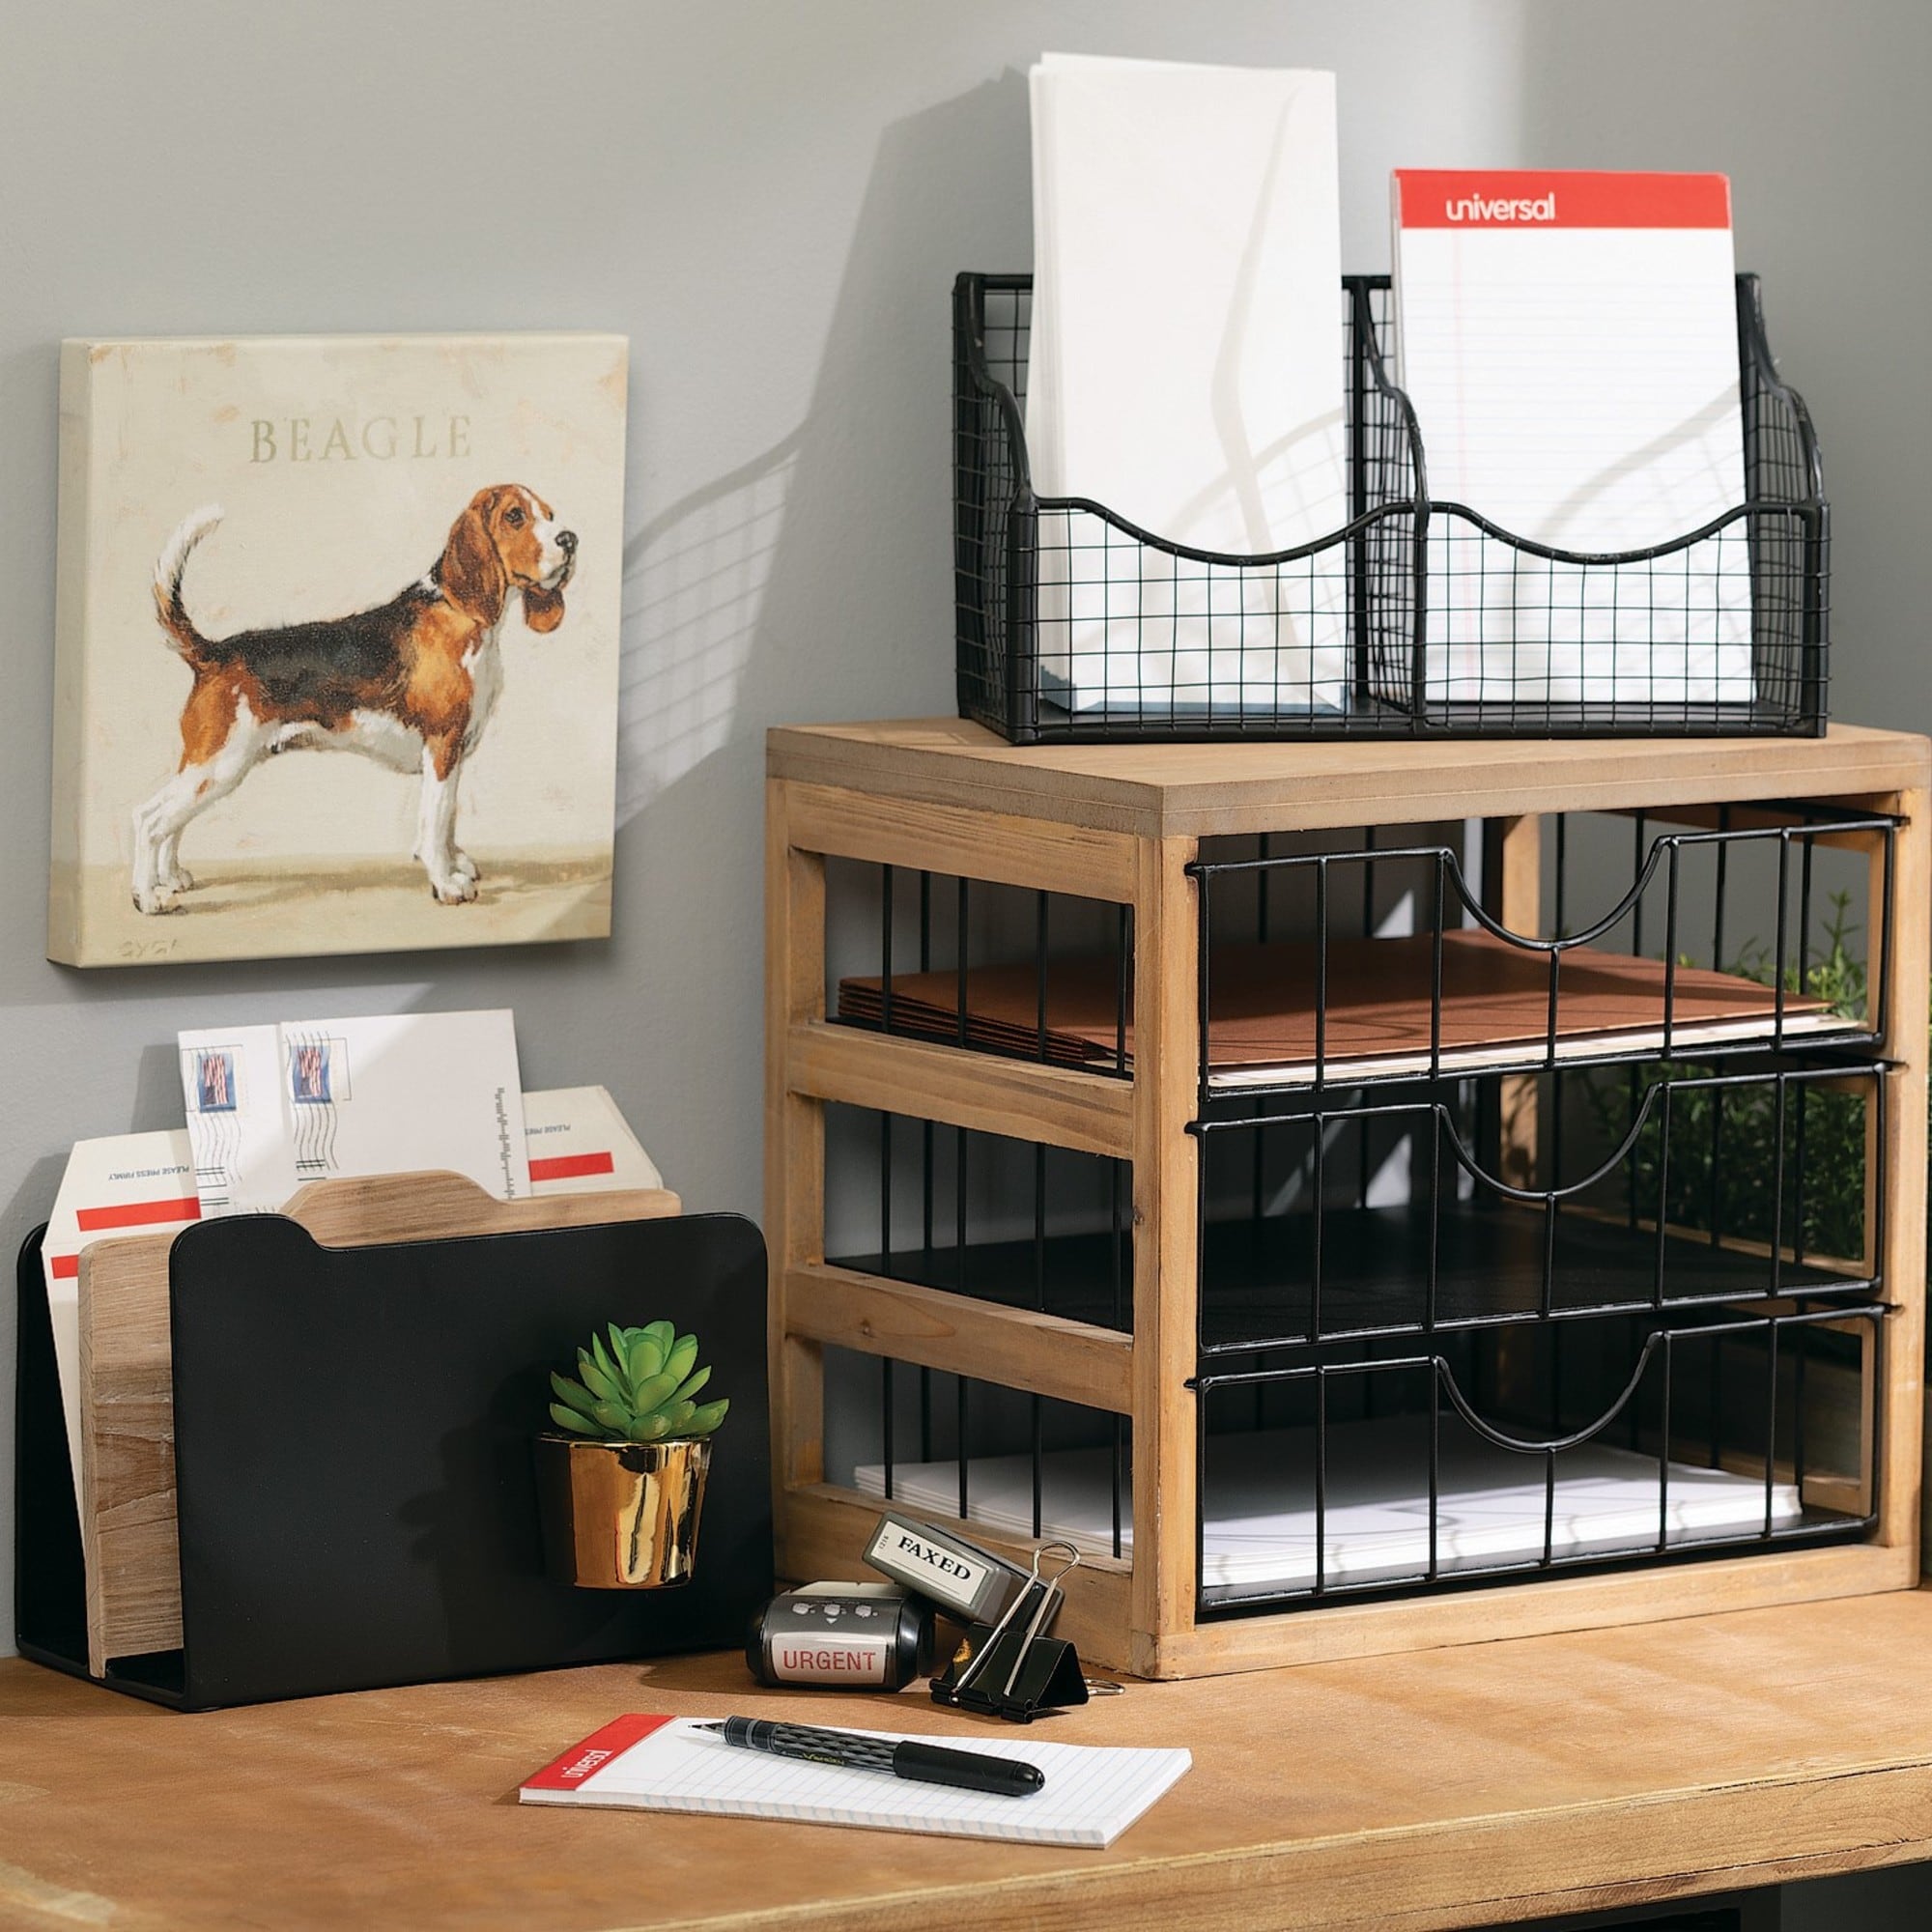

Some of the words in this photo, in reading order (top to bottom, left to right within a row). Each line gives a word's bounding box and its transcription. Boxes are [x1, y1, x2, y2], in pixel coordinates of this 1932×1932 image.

[1445, 191, 1555, 220] universal
[249, 414, 471, 464] BEAGLE
[108, 1172, 135, 1180] FIRMLY
[136, 1169, 160, 1178] PRESS
[162, 1165, 189, 1175] PLEASE
[897, 1536, 971, 1580] FAXED
[783, 1650, 876, 1670] URGENT
[560, 1747, 613, 1778] universal
